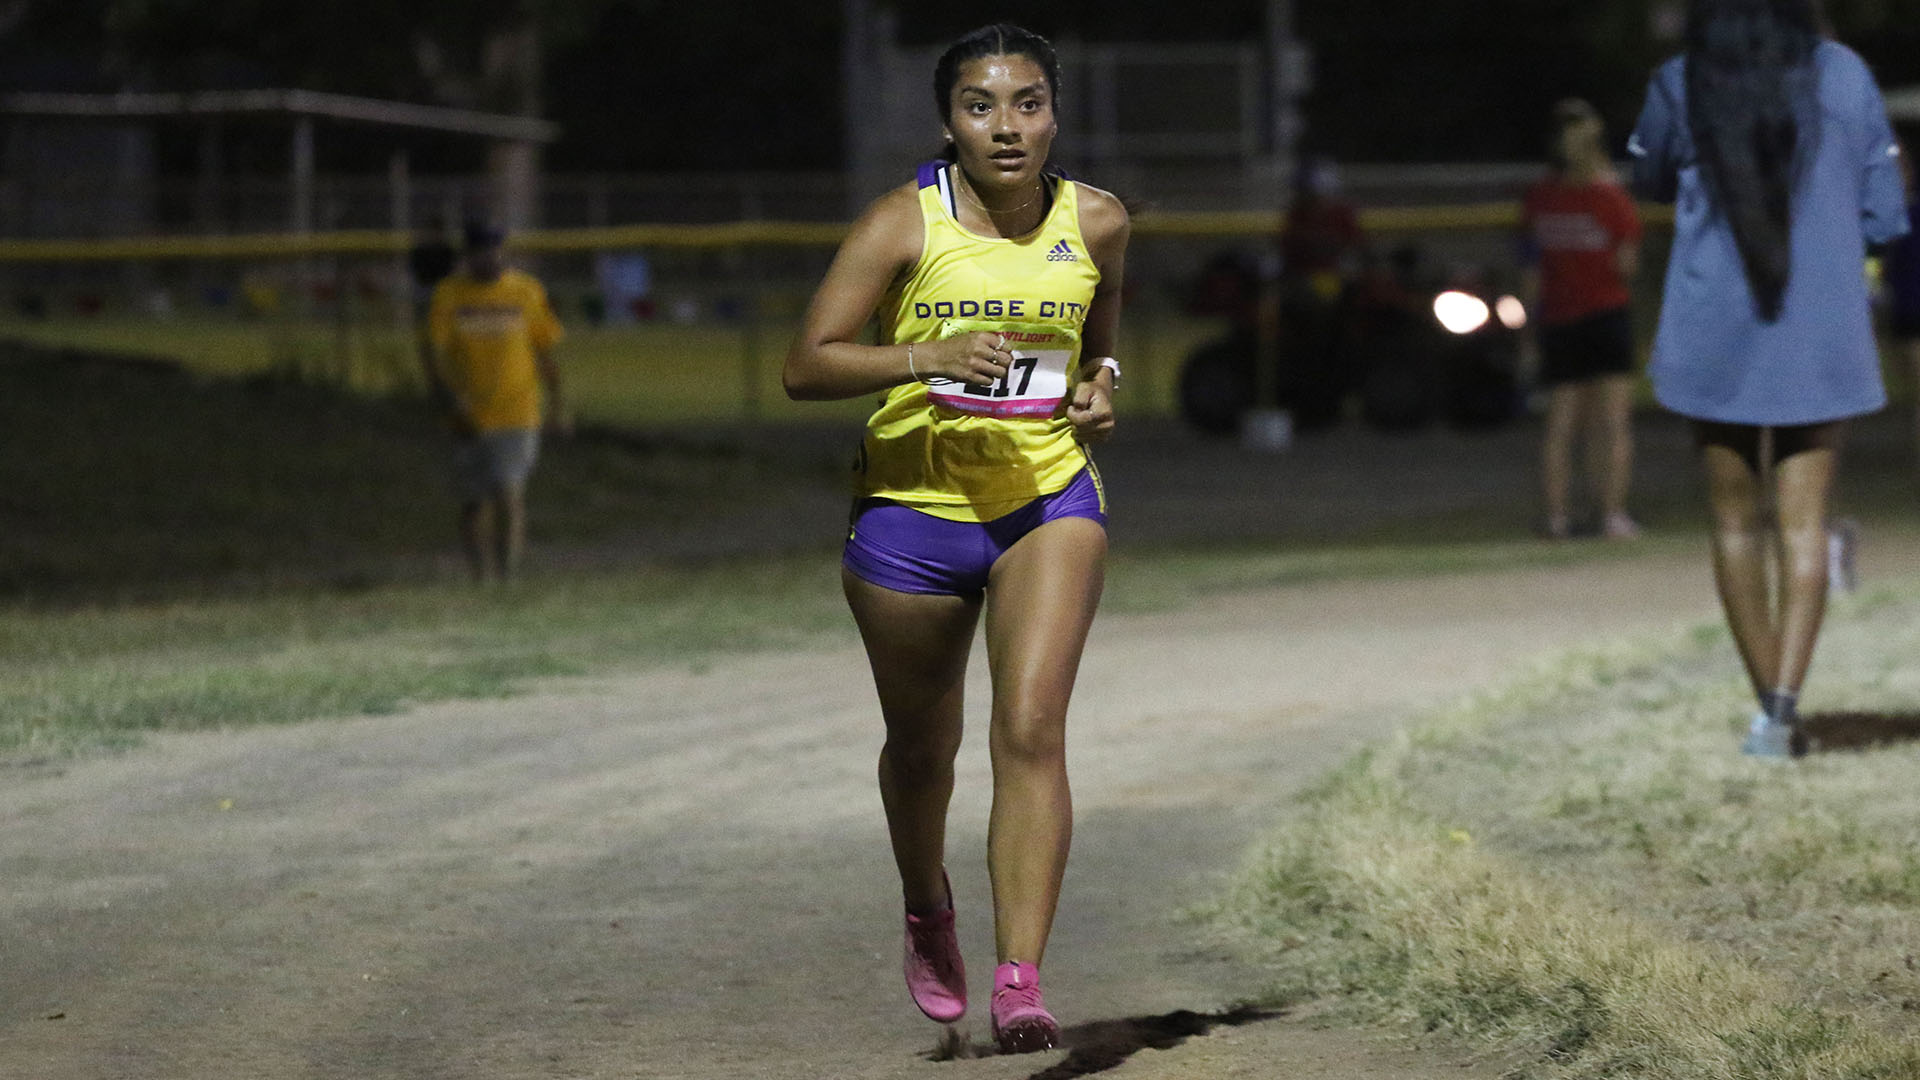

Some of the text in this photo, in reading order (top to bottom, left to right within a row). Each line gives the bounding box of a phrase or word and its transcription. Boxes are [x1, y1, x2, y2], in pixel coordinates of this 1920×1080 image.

[1046, 252, 1078, 262] adidas
[914, 300, 1088, 319] DODGE CITY
